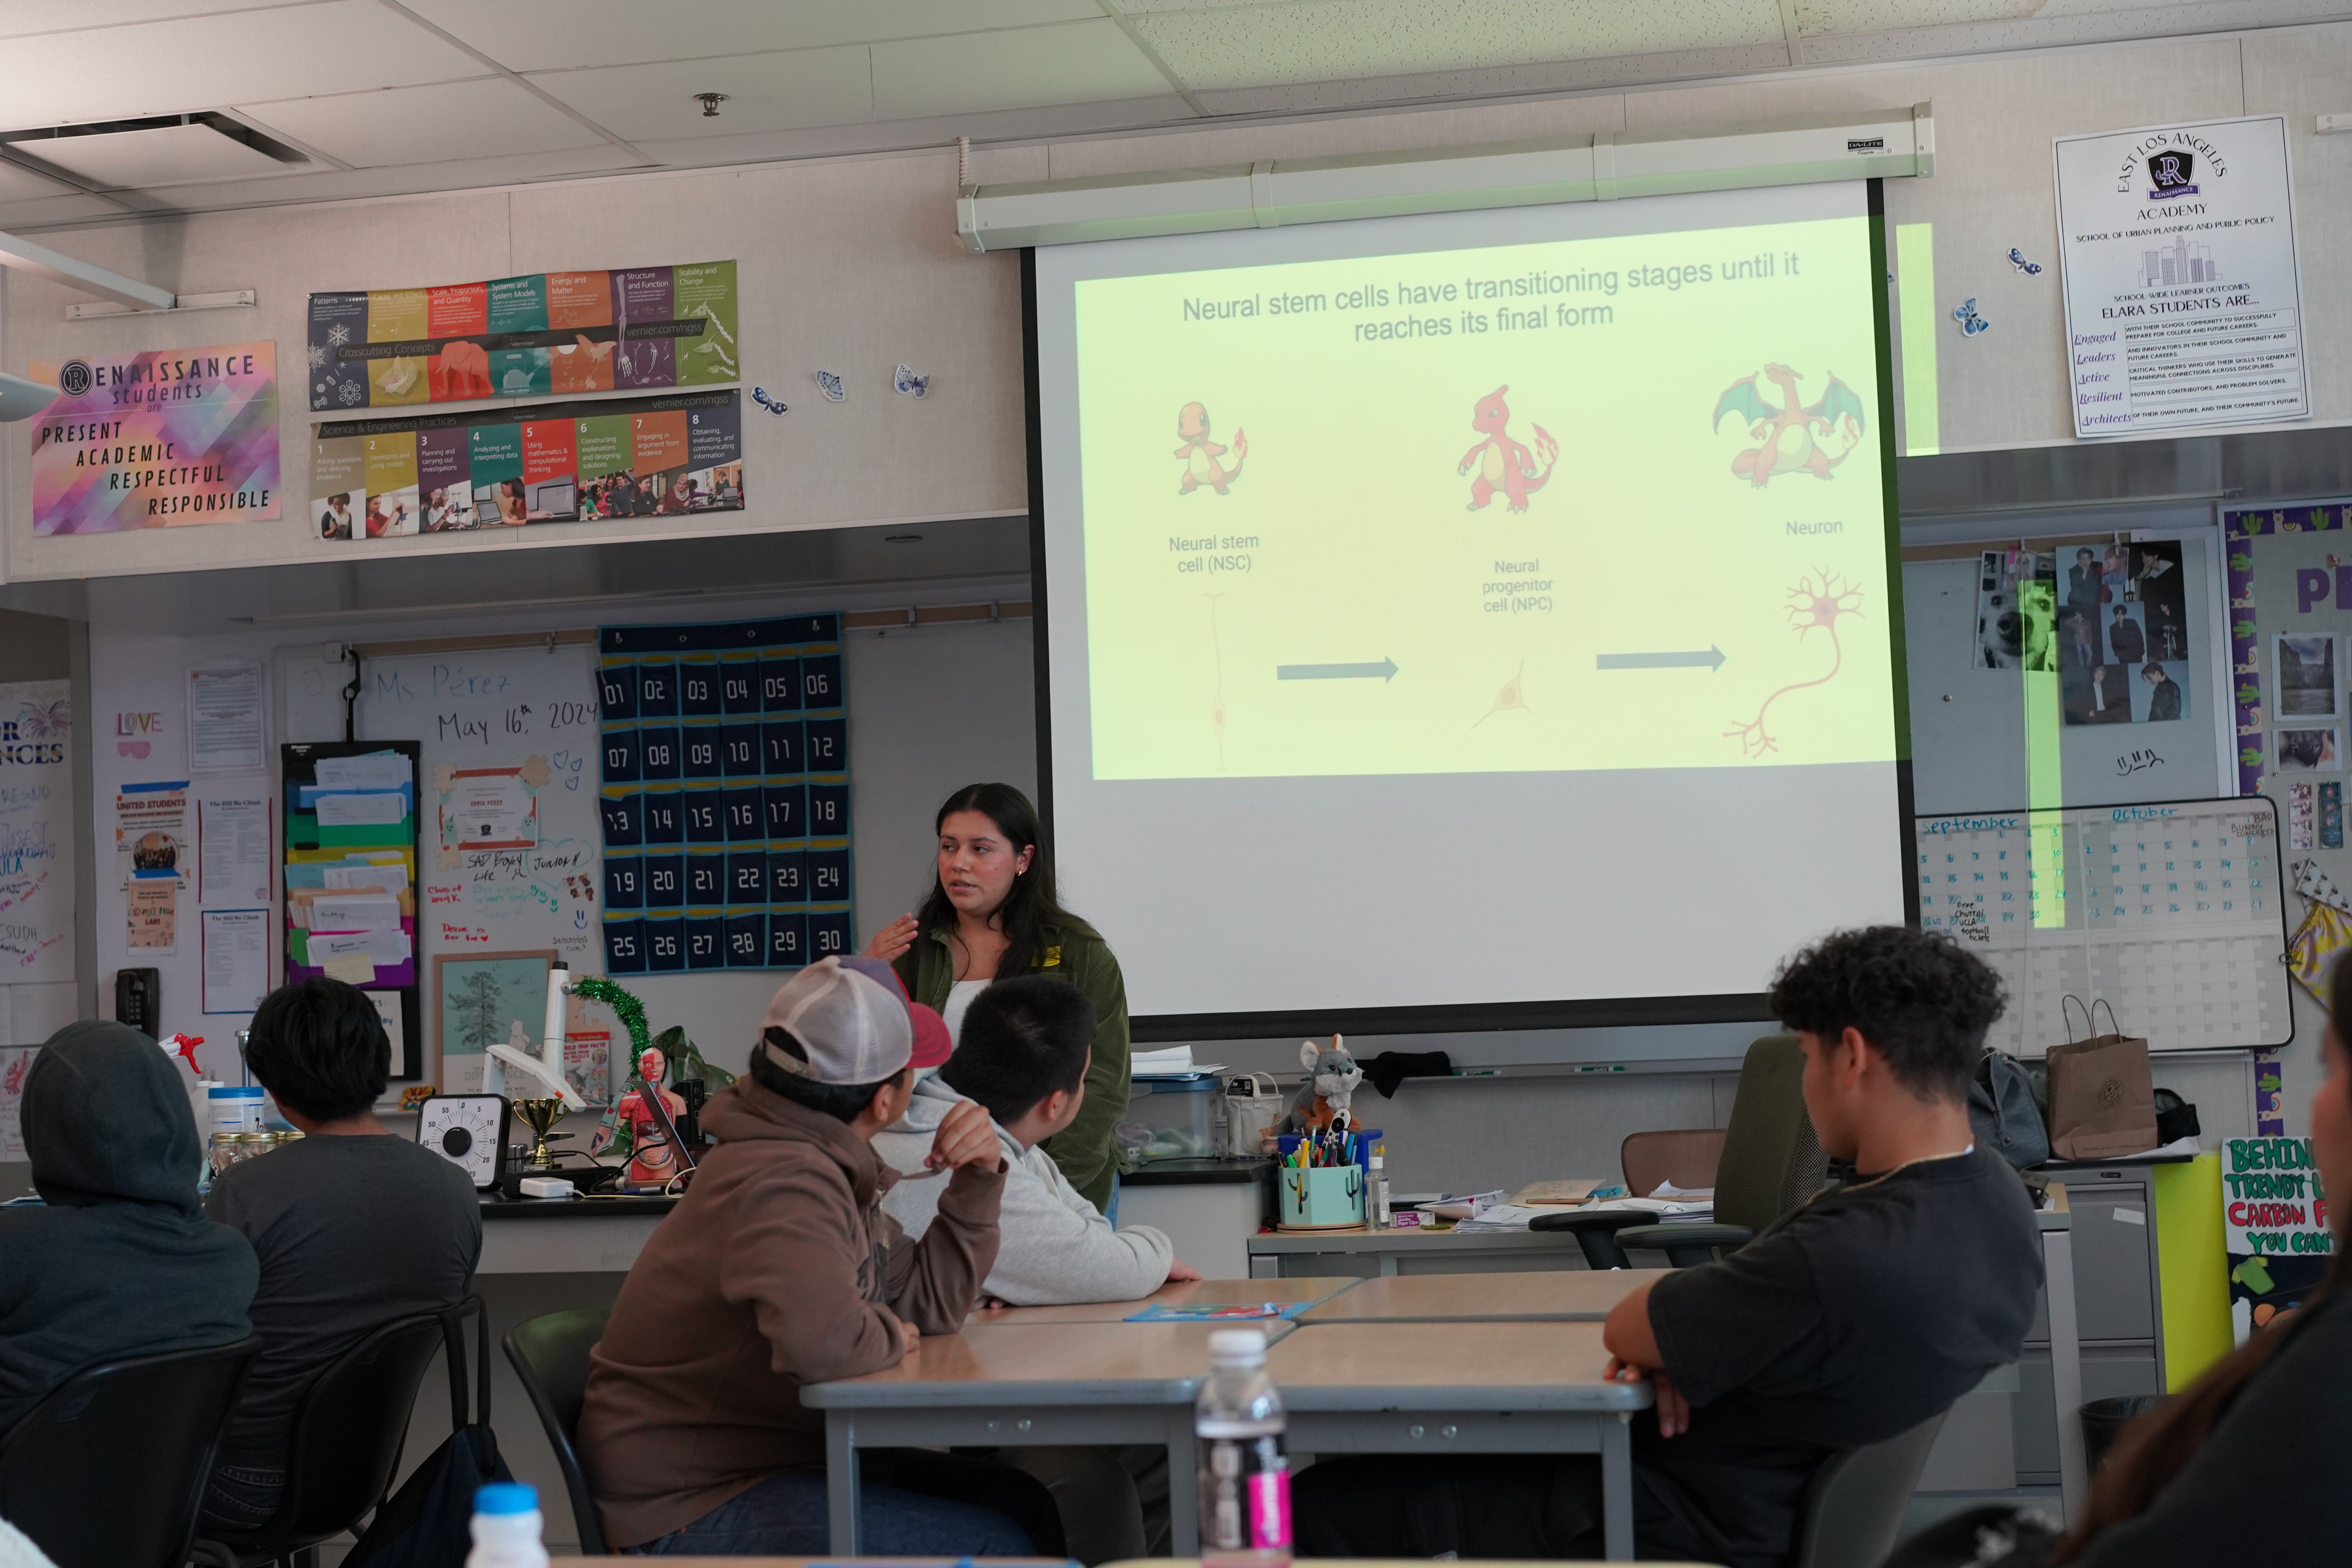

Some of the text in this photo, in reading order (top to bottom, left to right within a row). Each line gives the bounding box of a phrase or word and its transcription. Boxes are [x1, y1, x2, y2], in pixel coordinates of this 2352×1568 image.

[2118, 132, 2227, 192] EAST LOS ANGELES
[2154, 187, 2193, 198] RENAISSANCE
[2137, 203, 2207, 220] ACADEMY
[2076, 233, 2110, 242] SCHOOL
[2126, 229, 2152, 237] URBAN
[2154, 225, 2193, 235] PLANNING
[2215, 220, 2243, 228] PUBLIC
[2245, 216, 2274, 225] POLICY
[679, 268, 703, 277] Stability
[451, 286, 483, 294] Proportion,
[492, 283, 515, 292] Systems
[552, 278, 572, 286] Energy
[680, 278, 703, 286] Change
[1183, 252, 1800, 321] Neural stem cells have transitioning stages until it
[446, 296, 471, 304] Quantity
[492, 293, 512, 301] System
[2114, 283, 2249, 302] SCHOOL-WIDE LEARNER OUTCOMES
[2102, 295, 2259, 319] ELARA STUDENTS ARE...
[1354, 303, 1613, 342] reaches its final form
[2187, 318, 2222, 326] COMMUNITY
[2234, 313, 2276, 321] SUCCESSFULLY
[627, 321, 702, 336] vernier.com/ngss
[2074, 331, 2116, 345] Engaged
[339, 343, 435, 357] Crosscutting Concepts
[2076, 352, 2116, 365] Leaders
[2078, 372, 2110, 384] Active
[113, 383, 202, 405] students
[652, 394, 728, 409] vernier.com/ngss
[2080, 392, 2123, 405] Resilient
[147, 403, 162, 413] are
[322, 425, 353, 436] Science
[367, 419, 417, 432] Engineering
[420, 416, 457, 426] Practices
[2082, 413, 2132, 426] Architects
[42, 421, 121, 444] PRESENT
[637, 433, 662, 441] Engaging
[76, 443, 174, 466] ACADEMIC
[422, 449, 443, 458] Planning
[693, 443, 734, 452] communicating
[422, 457, 442, 465] carrying
[423, 465, 457, 473] investigations
[110, 465, 224, 490] RESPECTFUL
[149, 490, 269, 515] RESPONSIBLE
[1786, 521, 1843, 535] Neuron
[1170, 535, 1259, 552] Neural stem
[1178, 554, 1251, 575] cell (NSC)
[1495, 558, 1539, 573] Neural
[1483, 578, 1553, 596] progenitor
[1484, 595, 1552, 614] cell (NPC)
[605, 674, 828, 704] 01 02 03 04 05 06
[117, 713, 163, 736] LOVE
[439, 713, 488, 745] May
[550, 702, 599, 728] 2024
[608, 737, 833, 768] 07 08 09 10 11 12
[117, 799, 186, 810] UNITED STUDENTS
[607, 800, 835, 831] 13 14 15 16 17 18
[2112, 807, 2179, 822] October
[1922, 817, 2018, 834] September
[614, 867, 839, 893] 19 20 21 22 23 24
[2230, 1138, 2316, 1172] BEHIN
[2225, 1173, 2305, 1199] TRENDY
[2229, 1202, 2305, 1227] CARBON
[2246, 1232, 2287, 1254] YOU
